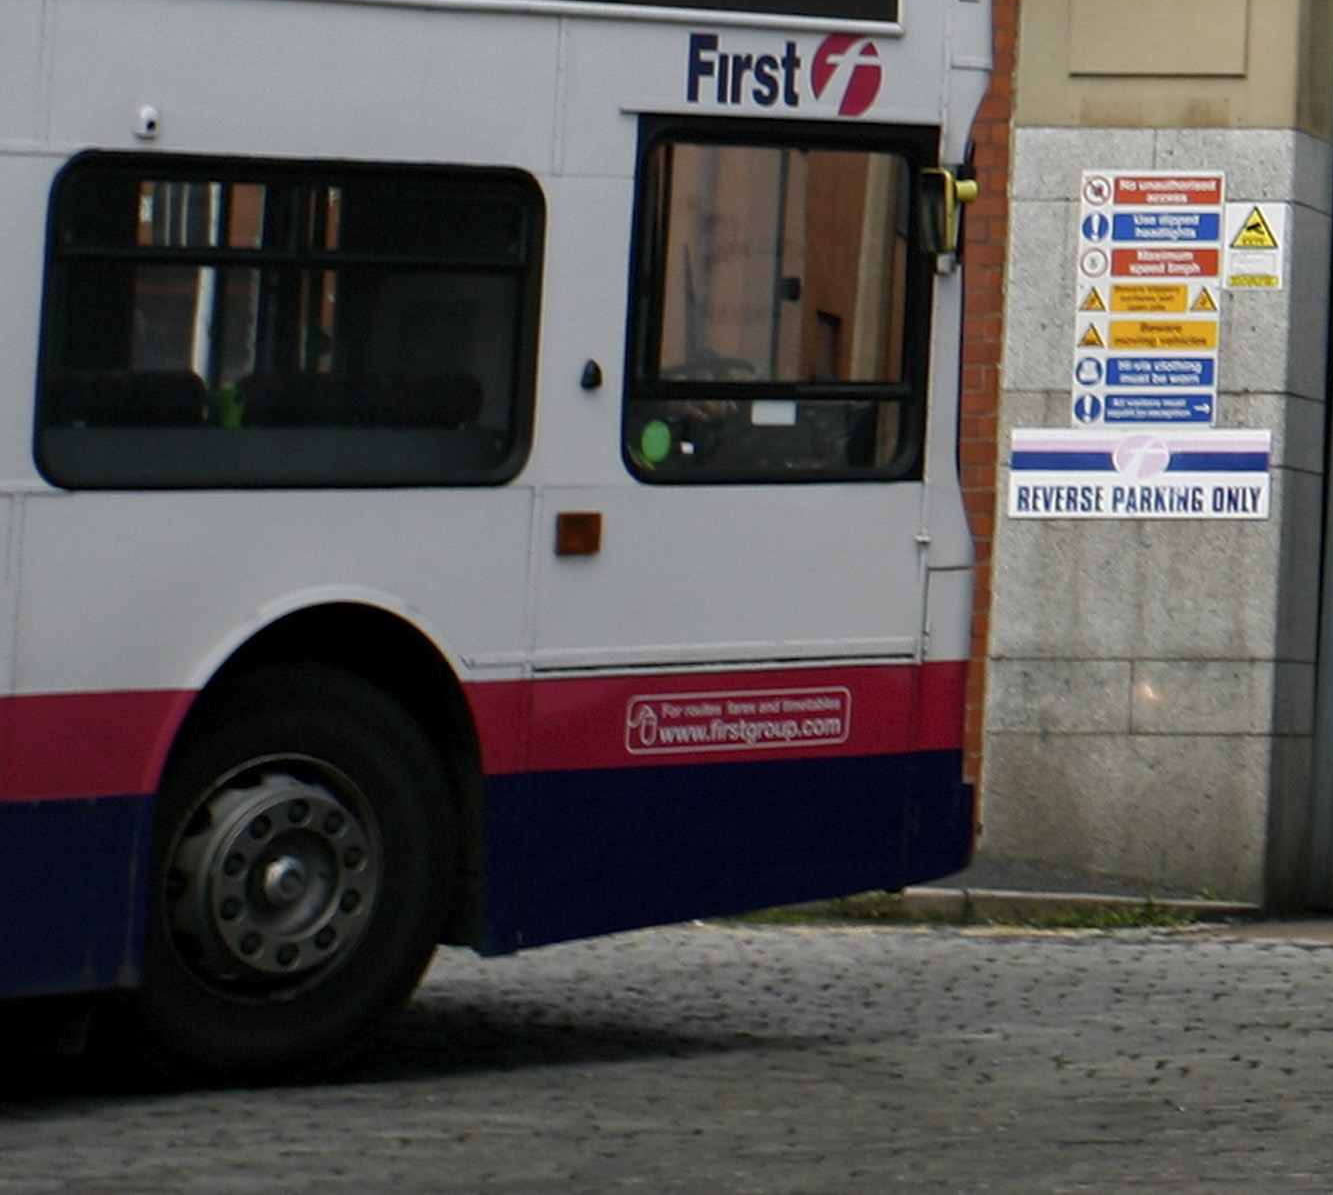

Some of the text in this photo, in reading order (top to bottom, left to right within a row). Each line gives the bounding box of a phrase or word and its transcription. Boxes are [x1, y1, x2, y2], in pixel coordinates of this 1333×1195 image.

[687, 34, 801, 107] First
[1017, 485, 1262, 514] REVERSE PARKING ONLY
[659, 717, 842, 745] www.firstgroup.com
